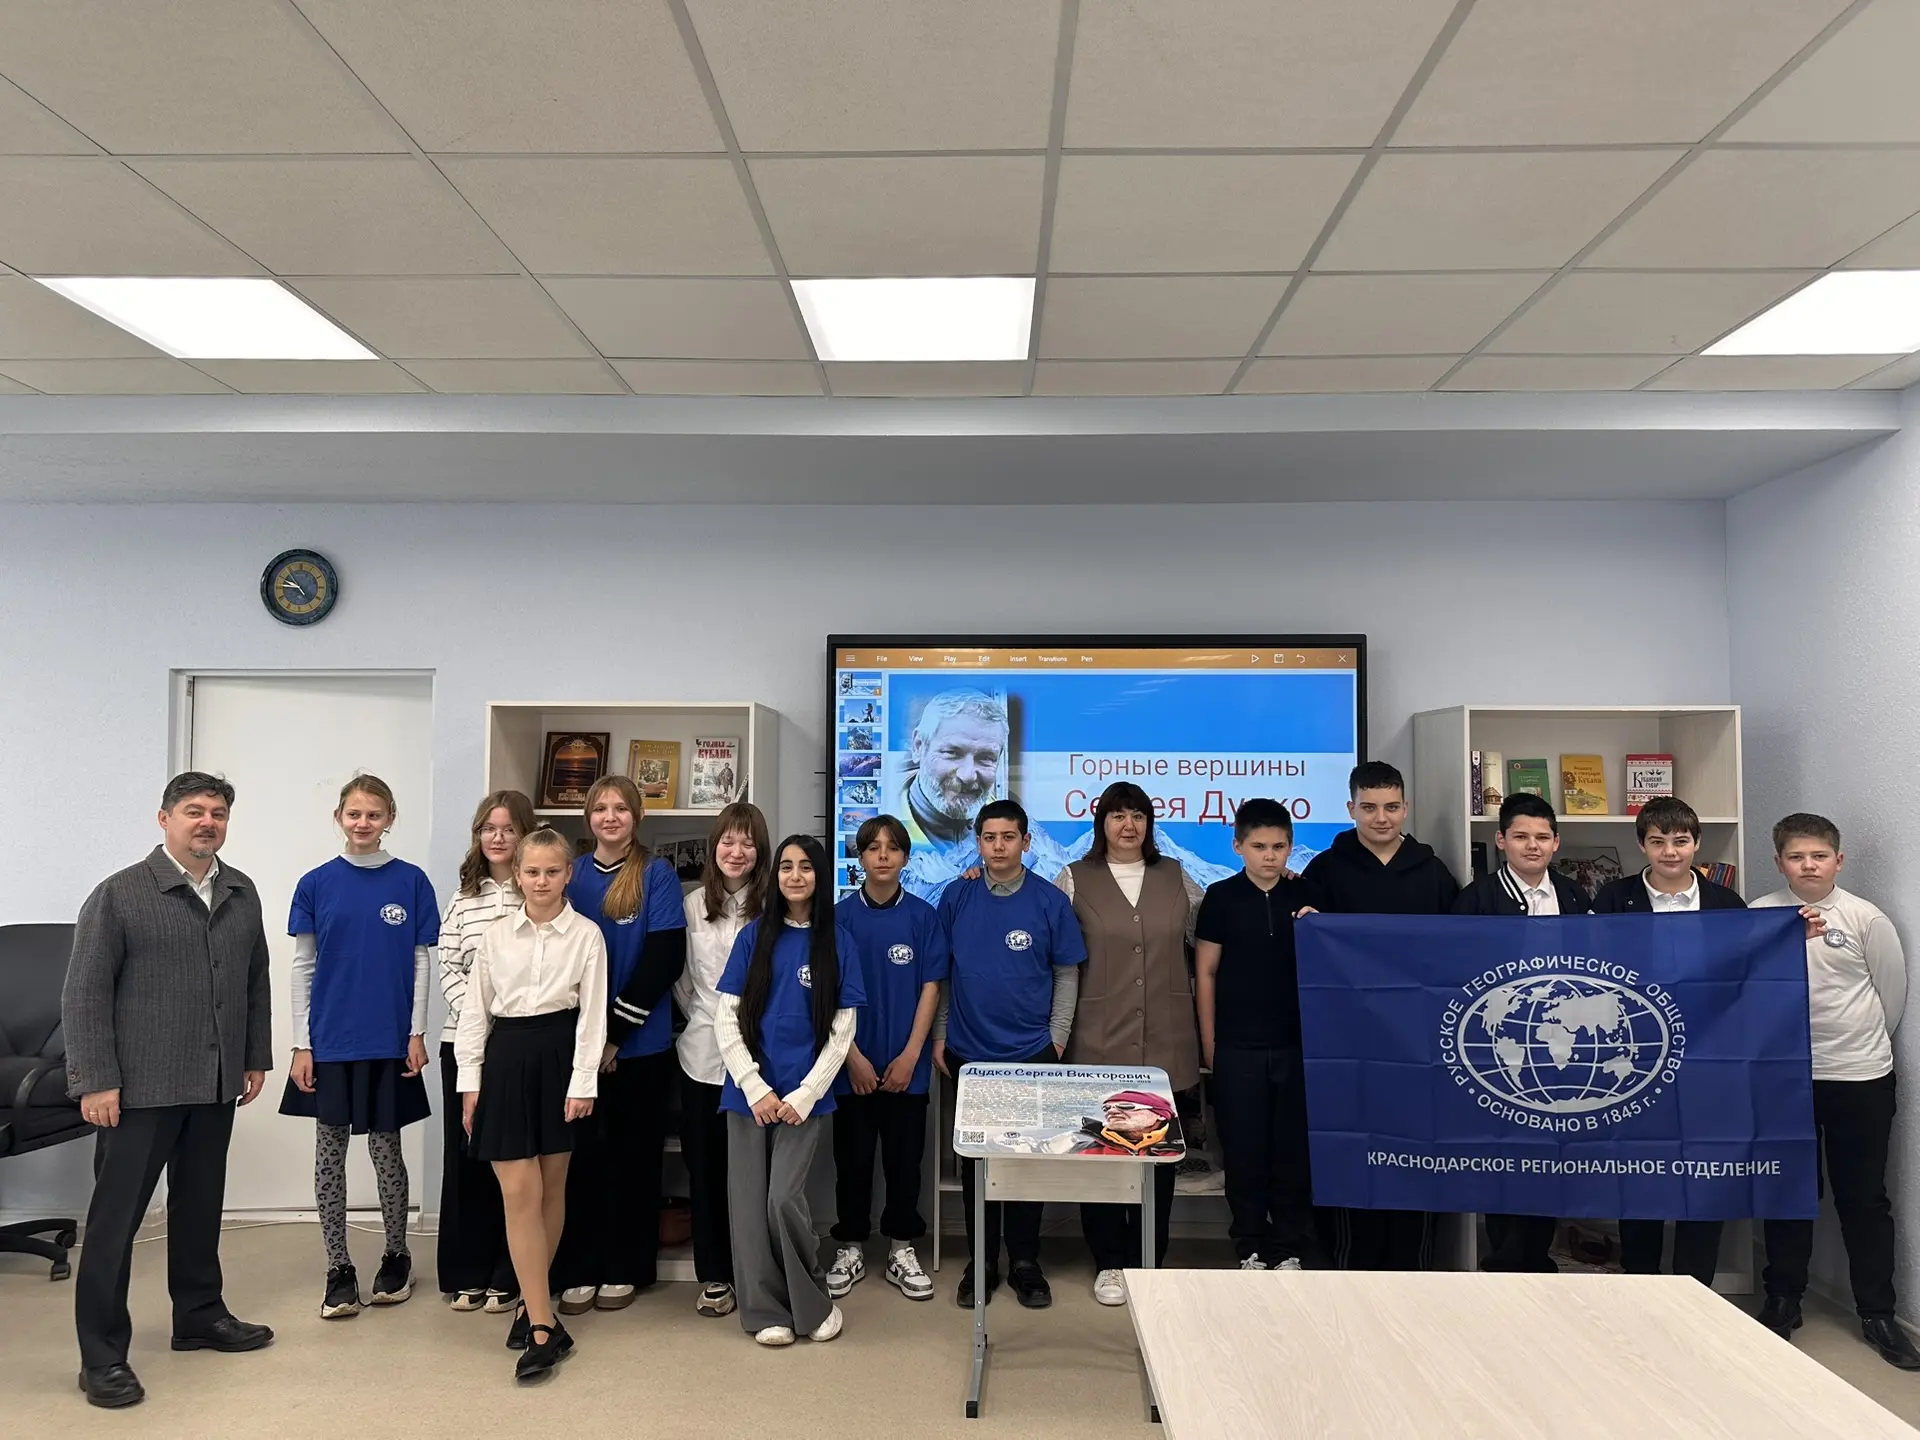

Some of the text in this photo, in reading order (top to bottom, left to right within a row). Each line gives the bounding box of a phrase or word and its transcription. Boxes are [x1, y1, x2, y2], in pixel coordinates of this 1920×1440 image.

[943, 655, 957, 664] Play
[1069, 754, 1306, 780] Горные вершины
[1065, 789, 1311, 827] Сея Дуо
[1439, 955, 1686, 1087] РУССКОЕ ГЕОГРАФИЧЕСКОЕ ОБЩЕСТВО
[966, 1067, 1151, 1081] Дудко Сергей Викторович
[1477, 1093, 1656, 1132] ОСНОВАНО В 1845 г.
[1367, 1150, 1781, 1180] КРАСНОДАРСКОЕ РЕГИОНАЛЬНОЕ ОТДЕЛЕНИЕ
